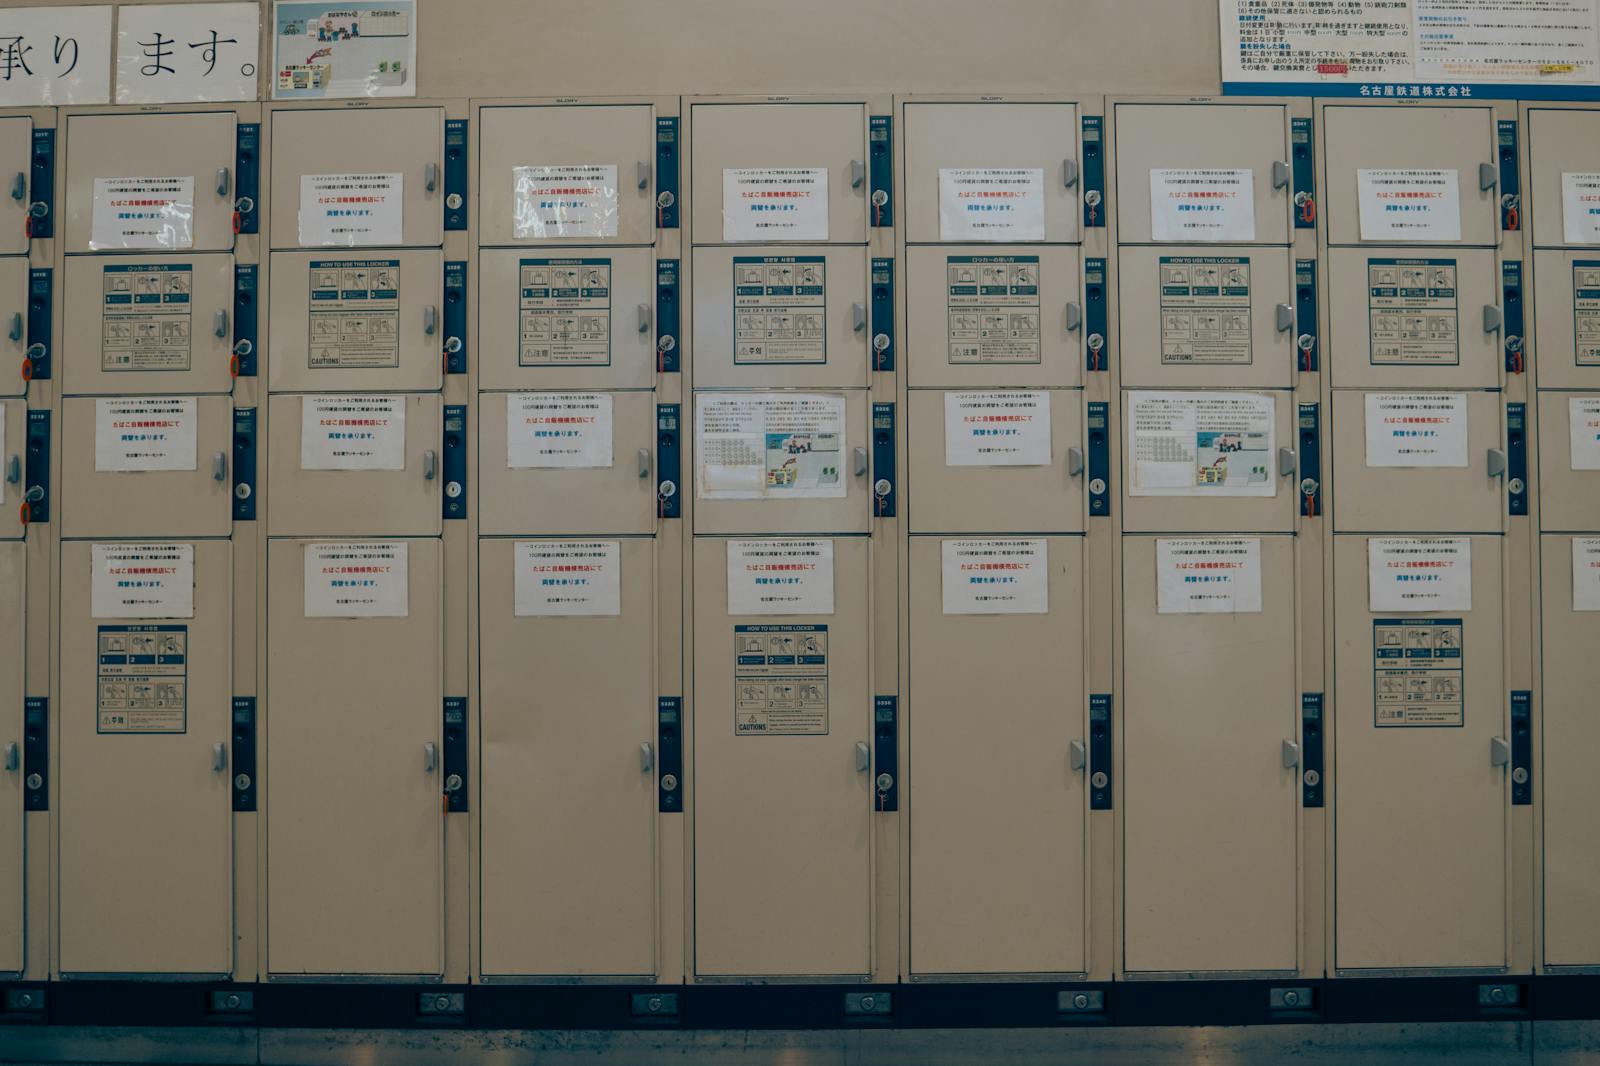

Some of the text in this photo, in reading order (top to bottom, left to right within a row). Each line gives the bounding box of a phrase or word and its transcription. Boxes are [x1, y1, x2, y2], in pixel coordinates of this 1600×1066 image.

[137, 30, 255, 77] ます。
[1360, 86, 1472, 97] 名古屋鉄道株式会社
